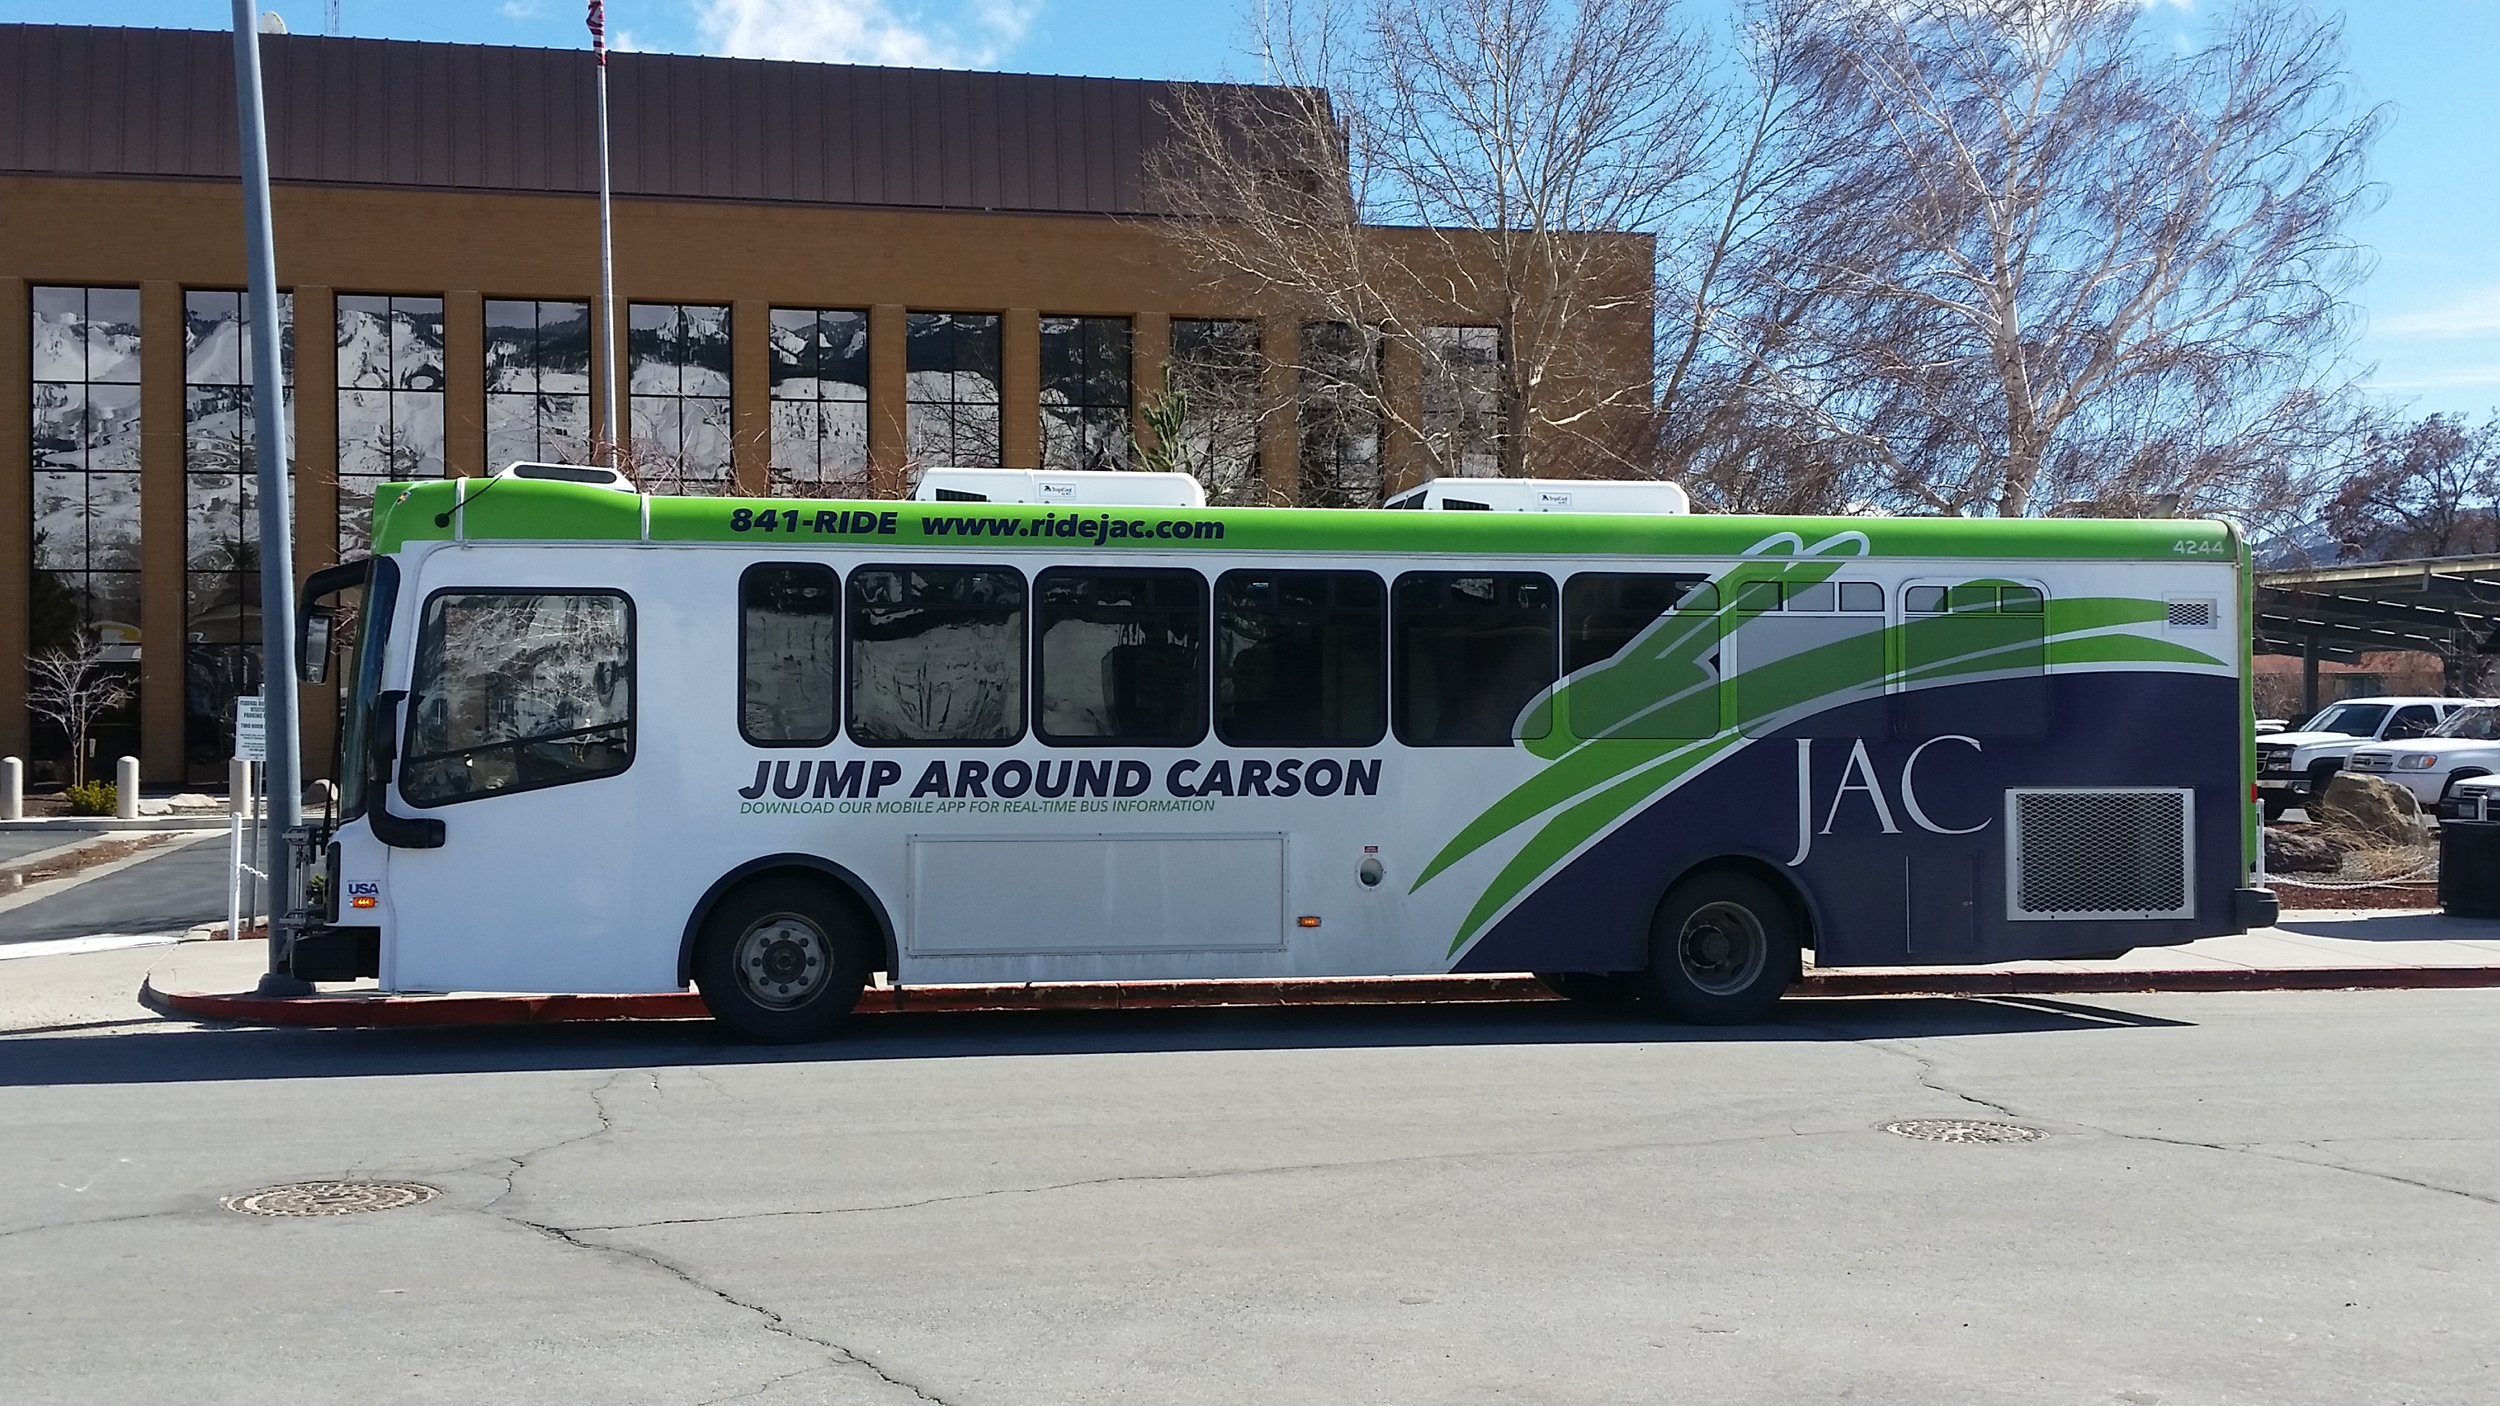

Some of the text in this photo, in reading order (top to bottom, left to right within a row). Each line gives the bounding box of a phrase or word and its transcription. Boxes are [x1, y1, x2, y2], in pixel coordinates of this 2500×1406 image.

[729, 508, 1225, 545] 841-RIDE www.ridejac.com
[2173, 540, 2225, 554] 4244
[738, 758, 1383, 800] JUMP AROUND CARSON
[740, 800, 1215, 814] DOWNLOAD OUR MOBILE APP FOR REAL-TIME BUS INFORMATION
[1786, 735, 1993, 866] JAC
[348, 883, 379, 894] USA
